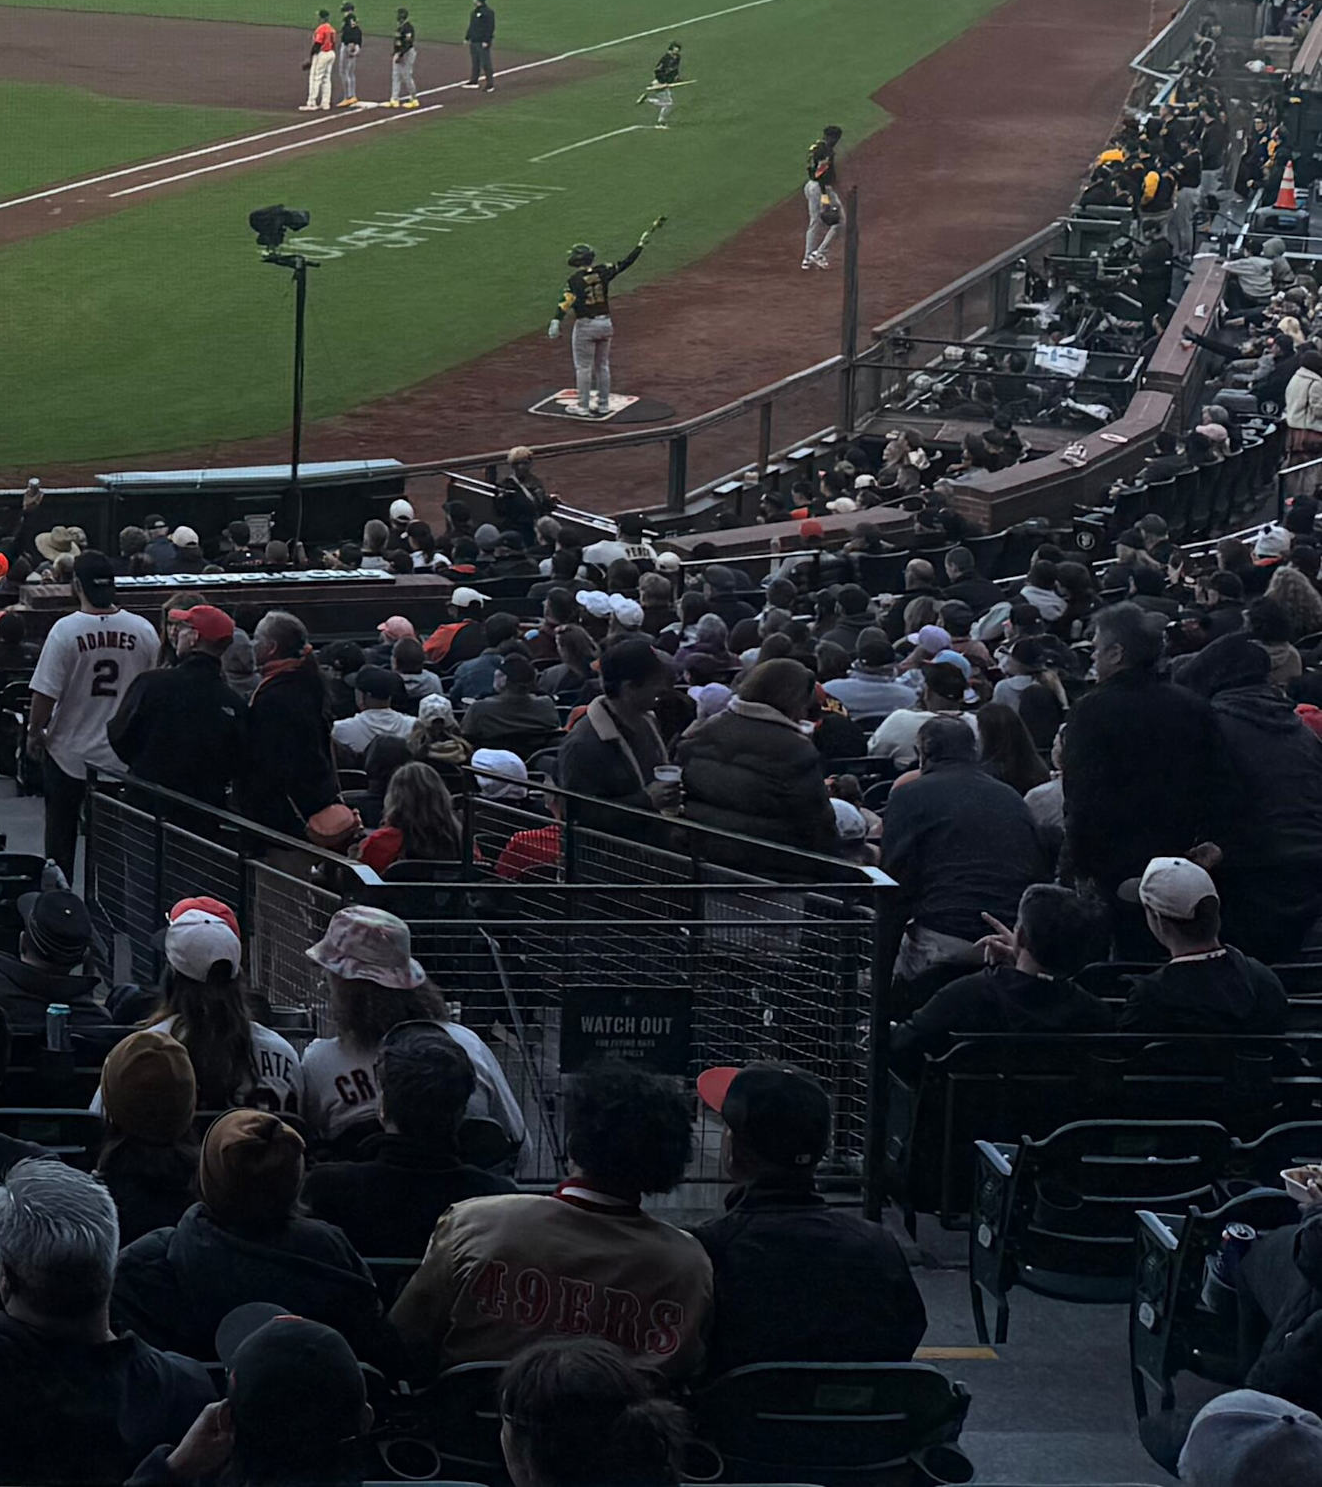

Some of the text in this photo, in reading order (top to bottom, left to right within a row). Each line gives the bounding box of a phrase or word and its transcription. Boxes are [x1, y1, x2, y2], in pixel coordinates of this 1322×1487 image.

[76, 630, 137, 653] ADAMES
[90, 658, 119, 697] 2
[580, 1015, 674, 1035] WATCH OUT
[472, 1258, 686, 1356] 49ERS
